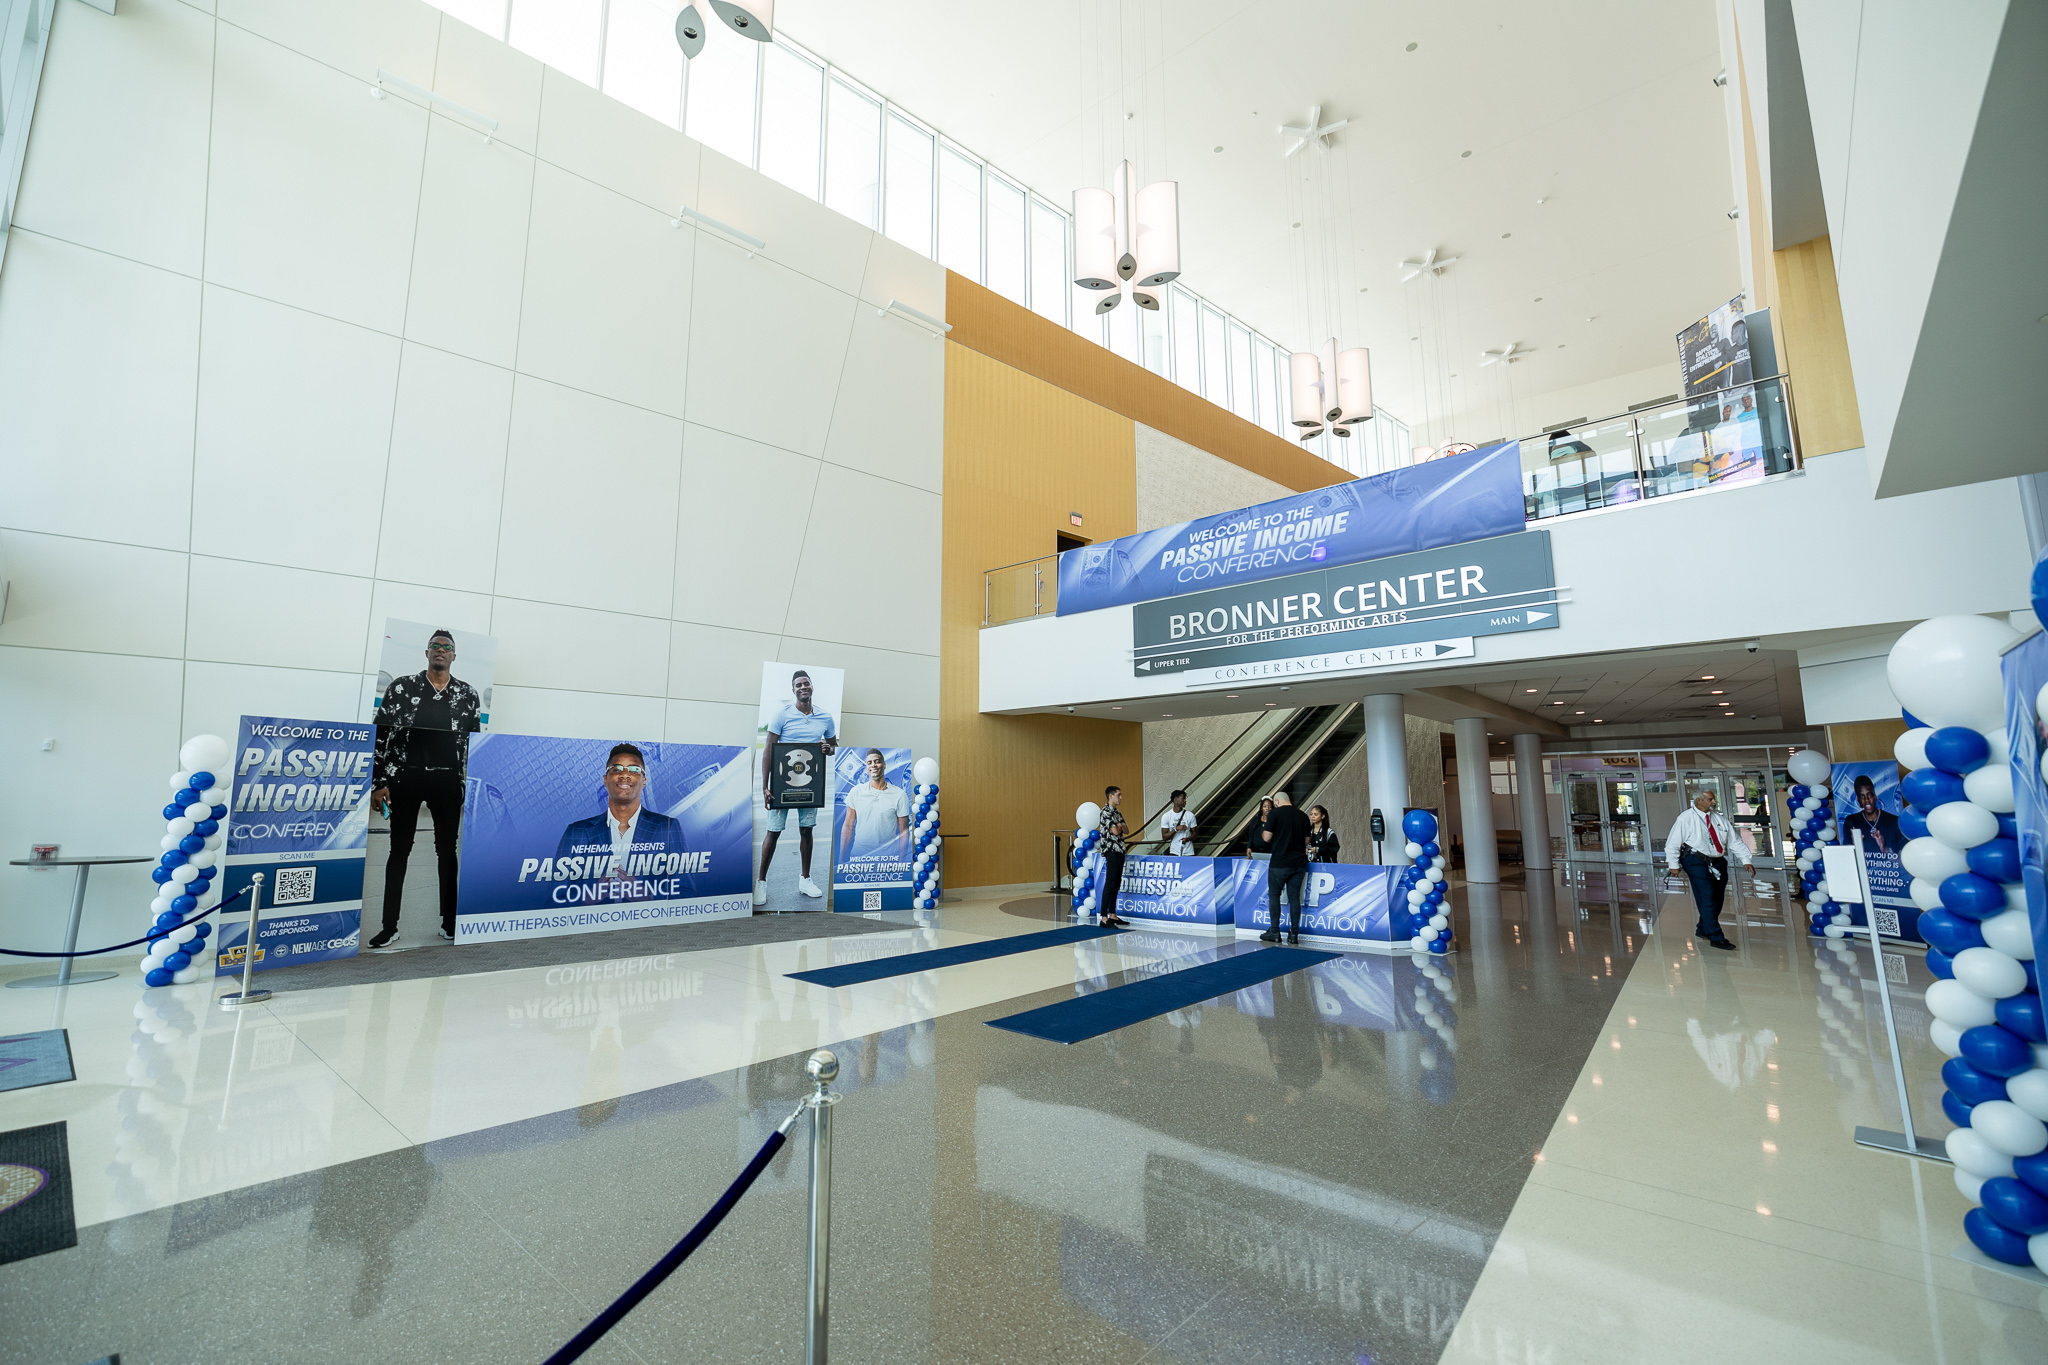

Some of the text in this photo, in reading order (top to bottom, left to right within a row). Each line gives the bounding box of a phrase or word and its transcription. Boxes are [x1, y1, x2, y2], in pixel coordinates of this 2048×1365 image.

[1189, 505, 1314, 544] WELCOME TO THE
[1160, 511, 1350, 570] PASSIVE INCOME
[1177, 539, 1326, 583] CONFERENCE
[1170, 565, 1488, 640] BRONNER CENTER
[1226, 611, 1407, 646] FOR THE PERFORMING ARTS
[1490, 615, 1521, 627] MAIN
[1154, 657, 1191, 669] UPPER TIER
[1215, 646, 1423, 680] CONFERENCE CENTER
[251, 724, 369, 741] WELCOME TO THE
[238, 748, 373, 778] PASSIVE
[234, 783, 363, 813] INCOME
[233, 821, 365, 839] CONFERENCE
[571, 842, 665, 854] NEHEMIAH PRESENTS
[1887, 852, 1899, 860] DO
[518, 851, 712, 883] PASSIVE INCOME
[836, 862, 911, 874] PASSIVE INCOME
[1866, 860, 1899, 869] YTHING IS
[1874, 869, 1887, 877] YOU
[1888, 870, 1900, 878] DO
[845, 872, 903, 882] CONFERENCE
[552, 878, 681, 904] CONFERENCE
[1120, 878, 1195, 897] DMISSION
[1117, 898, 1198, 917] EGISTRATION
[269, 920, 298, 930] THANKS
[460, 900, 750, 935] WWW.THEPASSIVEINCOMECONFERENCE.COM
[260, 924, 319, 938] OUR SPONSORS
